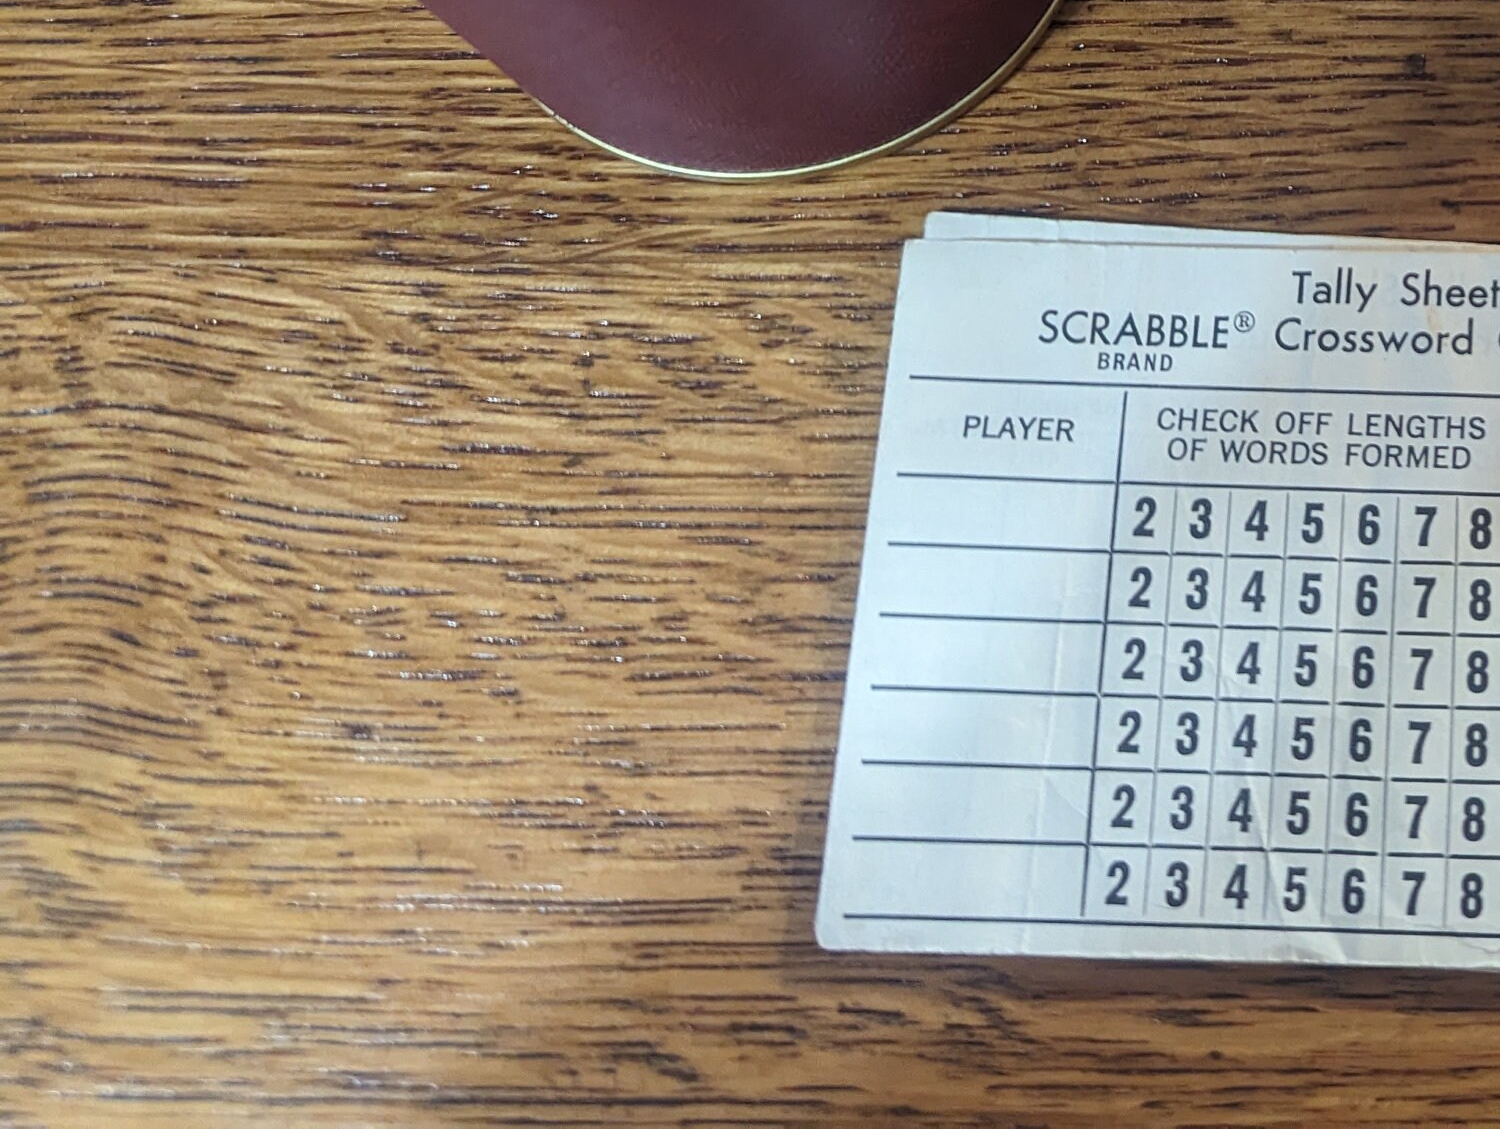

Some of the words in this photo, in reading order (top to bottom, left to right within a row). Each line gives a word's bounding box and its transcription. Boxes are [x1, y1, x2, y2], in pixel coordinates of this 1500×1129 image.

[1292, 267, 1378, 313] Tally
[1400, 269, 1500, 308] Sheet
[1275, 318, 1474, 355] Crossword
[1097, 352, 1173, 372] BRAND
[963, 415, 1074, 442] PLAYER
[1157, 407, 1259, 433] CHECK
[1275, 411, 1333, 435] OFF
[1348, 413, 1486, 440] LENGTHS
[1168, 437, 1207, 462] OF
[1220, 439, 1328, 465] WORDS
[1345, 443, 1471, 469] FORMED
[1132, 496, 1157, 538] 2
[1189, 498, 1212, 539] 3
[1244, 500, 1269, 541] 4
[1301, 502, 1324, 544] 5
[1358, 504, 1380, 545] 6
[1414, 506, 1437, 547] 7
[1469, 508, 1492, 550] 8
[1128, 566, 1152, 609] 2
[1185, 567, 1209, 610] 3
[1241, 570, 1266, 613] 4
[1298, 572, 1322, 615] 5
[1356, 574, 1378, 617] 6
[1413, 576, 1436, 618] 7
[1469, 579, 1491, 621] 8
[1122, 638, 1146, 681] 2
[1180, 639, 1204, 682] 3
[1236, 641, 1261, 685] 4
[1294, 644, 1318, 687] 5
[1352, 646, 1375, 689] 6
[1410, 648, 1433, 690] 7
[1466, 650, 1489, 694] 8
[1117, 710, 1142, 754] 2
[1175, 712, 1200, 756] 3
[1232, 714, 1258, 758] 4
[1290, 717, 1315, 761] 5
[1349, 718, 1372, 762] 6
[1408, 721, 1432, 764] 7
[1465, 723, 1488, 767] 8
[1110, 784, 1136, 829] 2
[1170, 785, 1194, 831] 3
[1227, 788, 1253, 833] 4
[1286, 790, 1310, 835] 5
[1344, 792, 1369, 837] 6
[1405, 795, 1429, 839] 7
[1462, 797, 1486, 842] 8
[1104, 860, 1130, 906] 2
[1165, 861, 1189, 909] 3
[1223, 864, 1249, 910] 4
[1283, 866, 1308, 912] 5
[1342, 868, 1366, 914] 6
[1402, 871, 1426, 916] 7
[1460, 873, 1484, 919] 8
